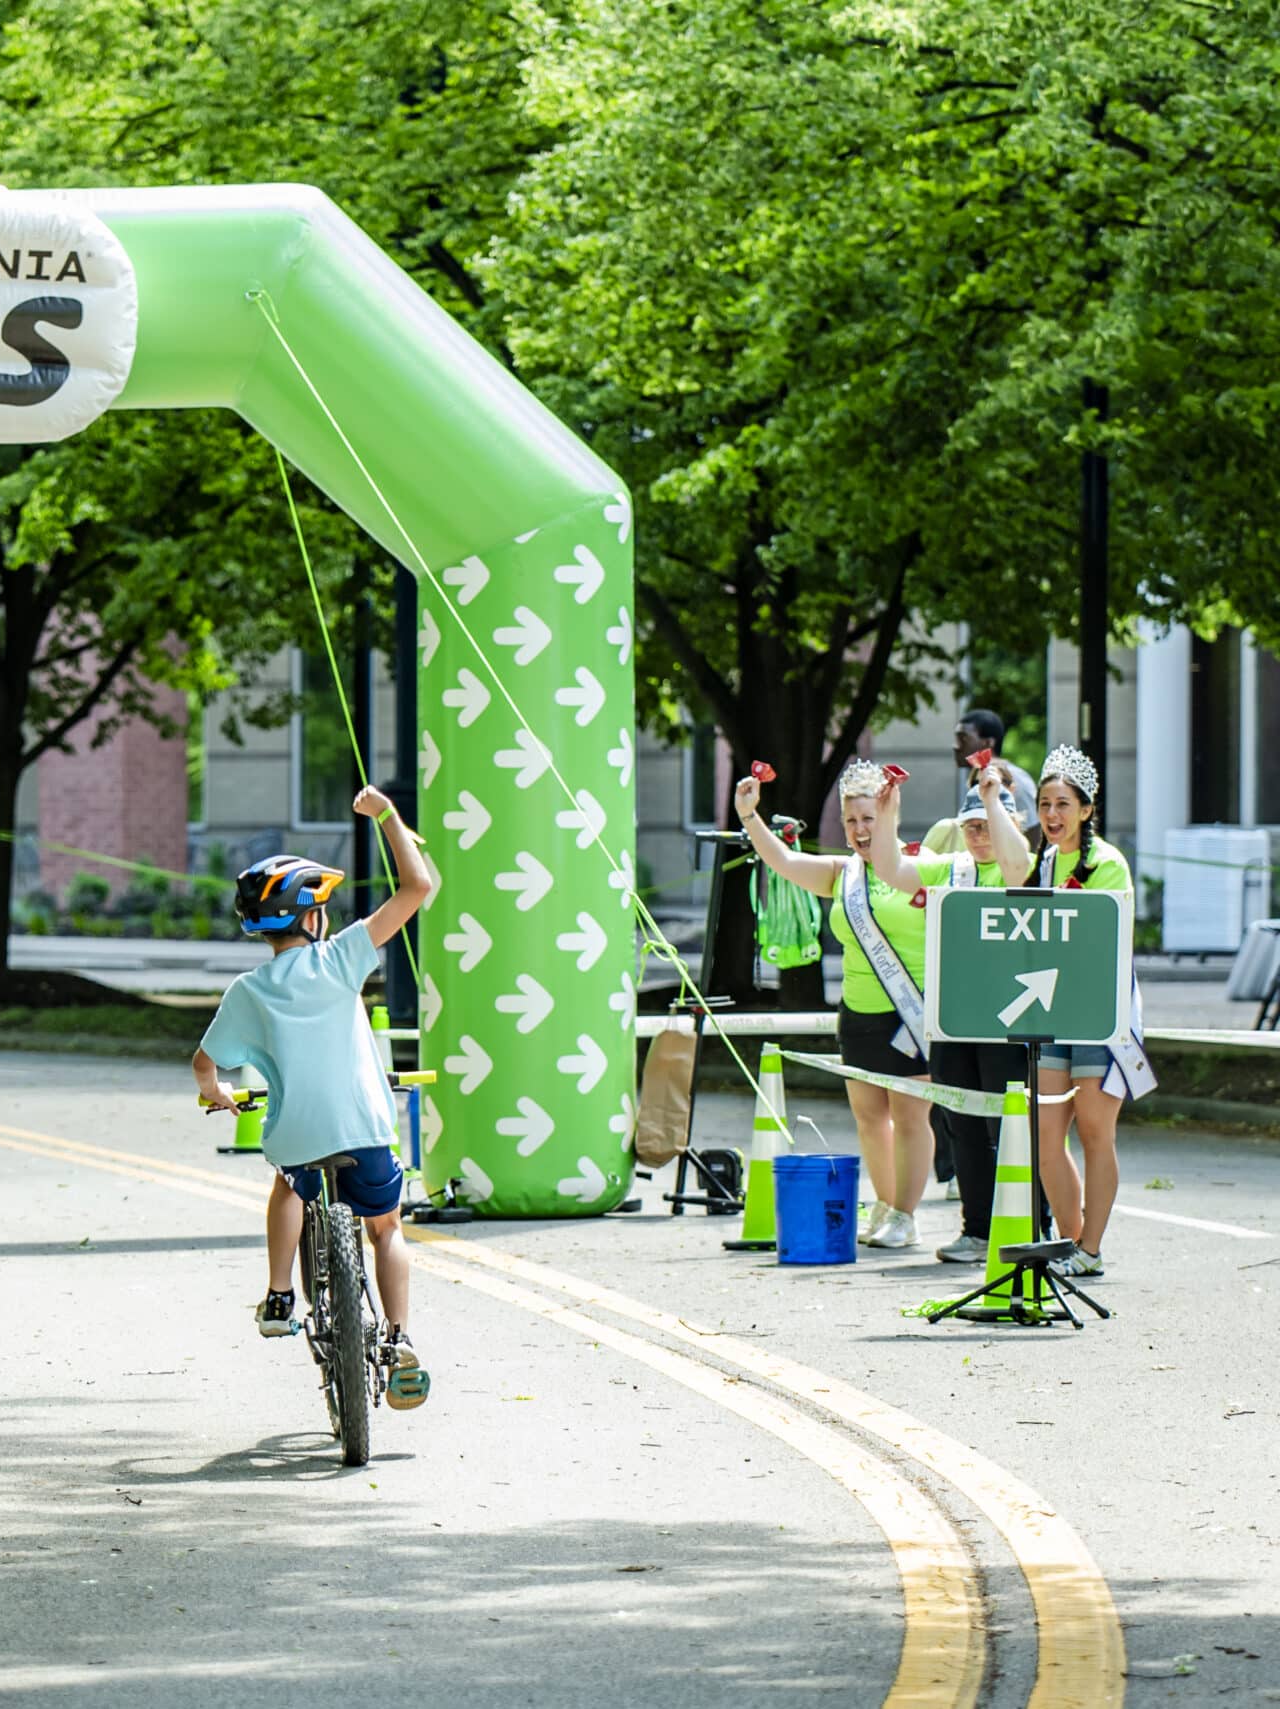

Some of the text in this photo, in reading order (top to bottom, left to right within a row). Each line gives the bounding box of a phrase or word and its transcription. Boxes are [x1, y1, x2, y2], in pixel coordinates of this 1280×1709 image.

[848, 888, 900, 980] Radiance World
[980, 907, 1079, 942] EXIT
